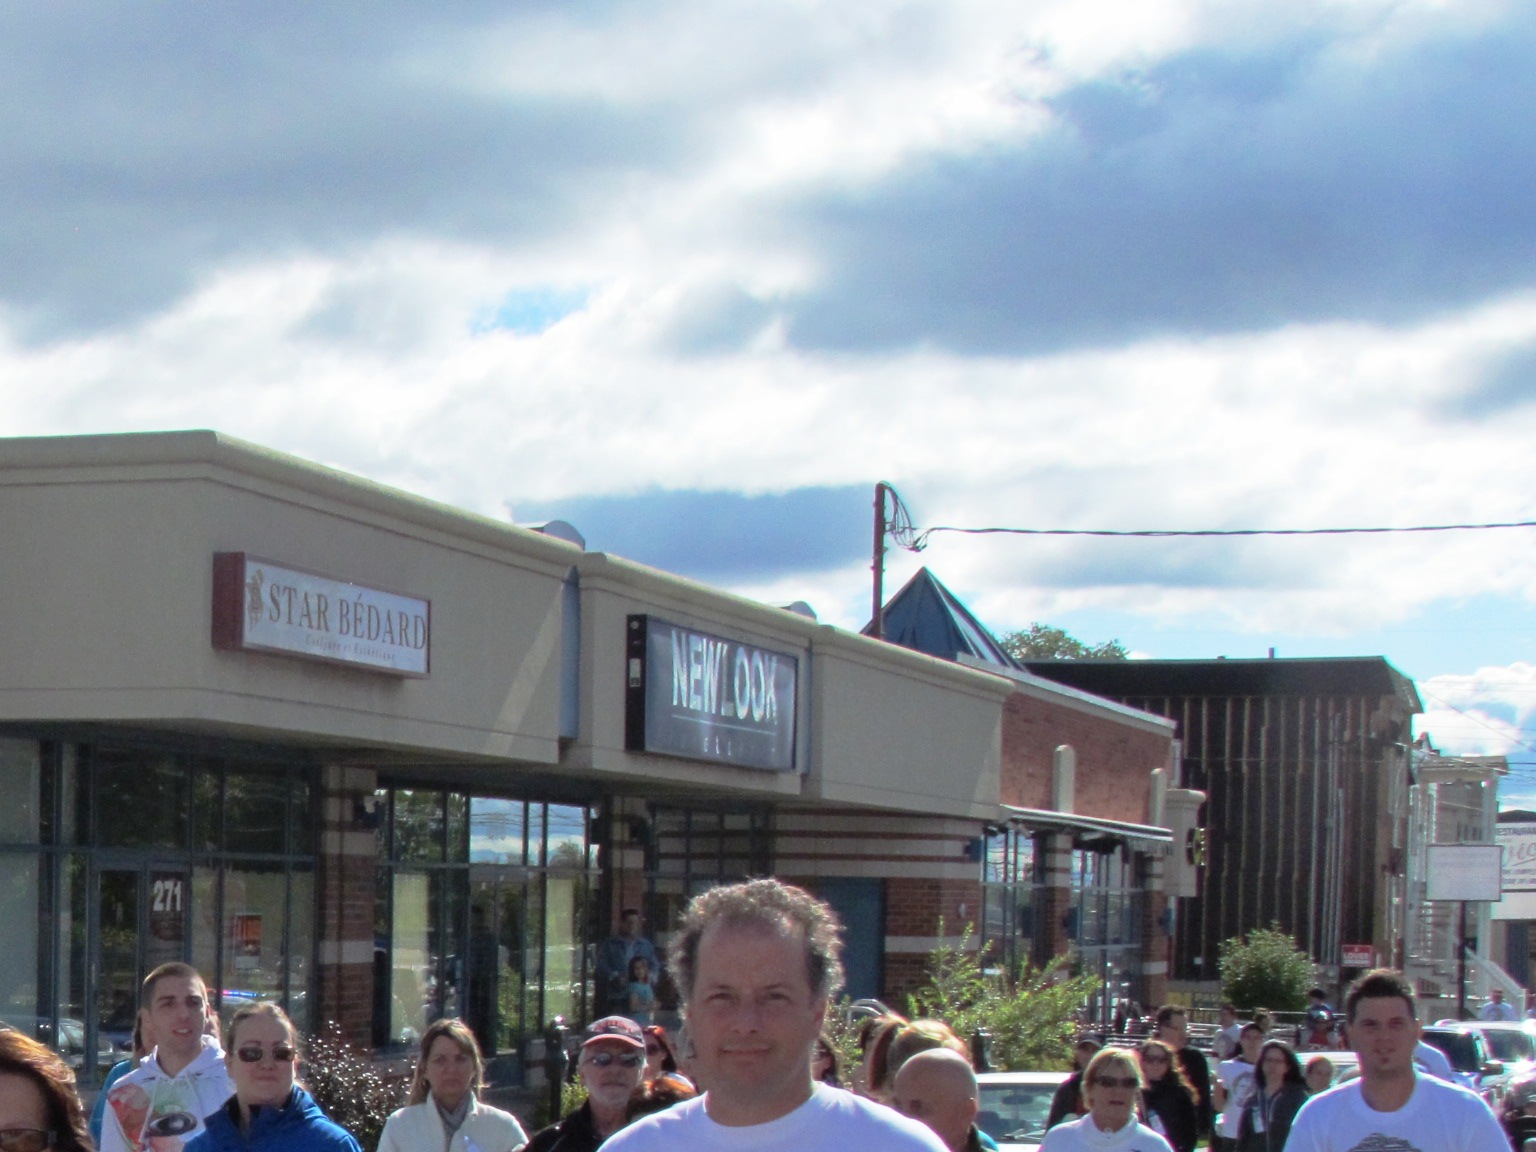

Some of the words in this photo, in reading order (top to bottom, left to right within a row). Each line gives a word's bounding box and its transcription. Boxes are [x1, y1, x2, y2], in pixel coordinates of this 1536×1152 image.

[268, 583, 330, 632] STAR
[338, 592, 427, 650] BÉDARD
[152, 880, 182, 911] 271
